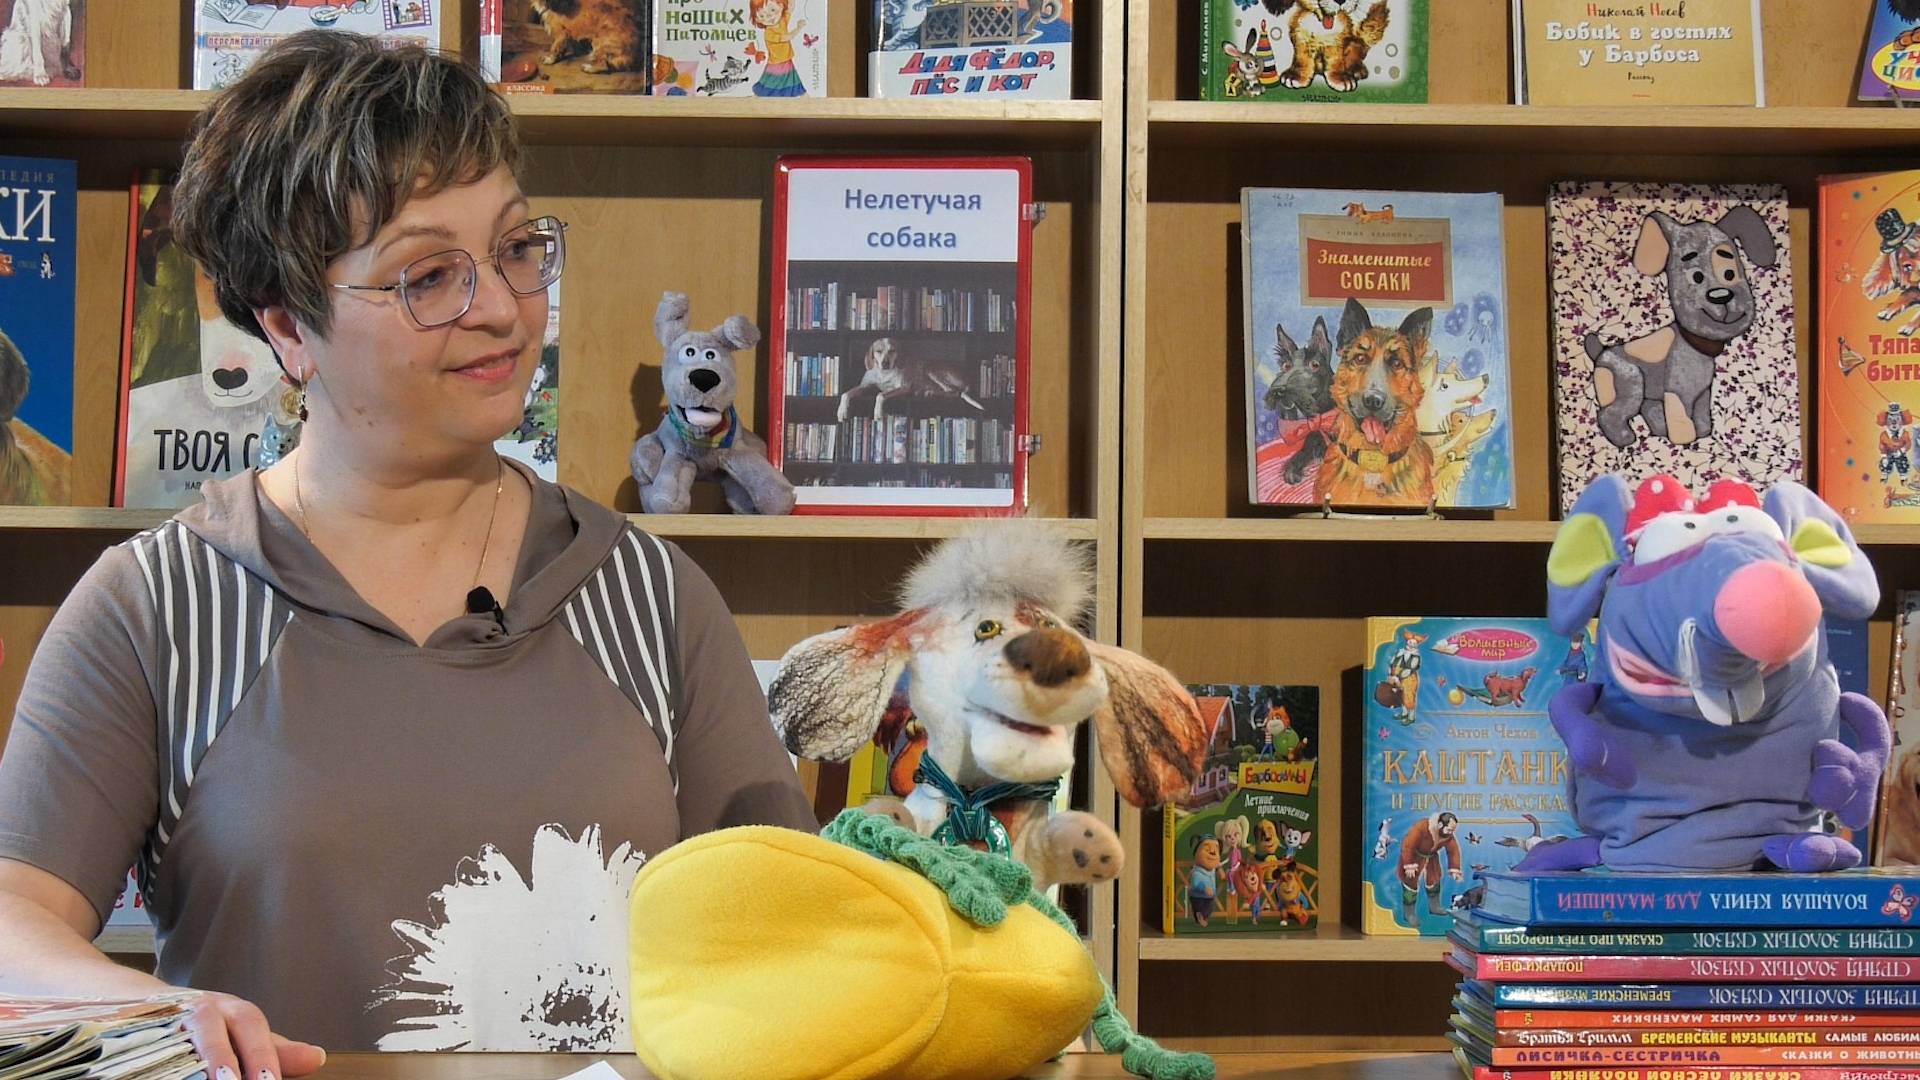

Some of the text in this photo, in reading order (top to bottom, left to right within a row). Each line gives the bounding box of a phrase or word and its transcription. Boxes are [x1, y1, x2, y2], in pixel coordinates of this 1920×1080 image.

[1587, 1, 1686, 19] Николай Носов
[1546, 22, 1733, 41] Бобик в гостях
[1579, 44, 1701, 68] у Барбоса
[910, 73, 1039, 95] ПЁС И КОТ
[844, 188, 982, 214] Нелетучая
[866, 226, 957, 248] собака
[1317, 249, 1433, 268] Знаменитые
[1340, 271, 1411, 292] СОБАКИ
[153, 429, 231, 473] ТВОЯ
[1444, 724, 1538, 739] Антон Чехов
[1391, 793, 1569, 812] И ДРУГИЕ РАССКА
[1558, 890, 1868, 912] БОЛЬШАЯ КНИГА ДЛЯ МАЛЫШЕЙ
[1497, 933, 1554, 945] ПОРОСЯТ
[1589, 934, 1614, 946] ПРО
[1618, 934, 1664, 946] СКАЗКА
[1693, 932, 1757, 949] СКАЗОК
[1763, 932, 1841, 949] ЗОЛОТЫХ
[1691, 960, 1755, 976] СКАЗОК
[1761, 960, 1837, 977] ЗОЛОТЫХ
[1593, 990, 1672, 1002] БРЕМЕНСКИЕ
[1709, 988, 1773, 1005] СКАЗОК
[1779, 989, 1856, 1005] ЗОЛОТЫХ
[1612, 1014, 1703, 1024] МАЛЕНЬКИХ
[1711, 1014, 1761, 1023] САМЫХ
[1768, 1014, 1796, 1023] ДЛЯ
[1516, 1029, 1574, 1047] Братья
[1576, 1032, 1633, 1046] Гримм
[1641, 1032, 1727, 1045] БРЕМЕНСКИЕ
[1731, 1031, 1817, 1044] МУЗЫКАНТЫ
[1824, 1032, 1868, 1042] САМЫЕ
[1516, 1050, 1721, 1062] ЛИСИЧКА-СЕСТРИЧКА
[1781, 1051, 1833, 1060] СКАЗКИ
[1839, 1051, 1849, 1060] О
